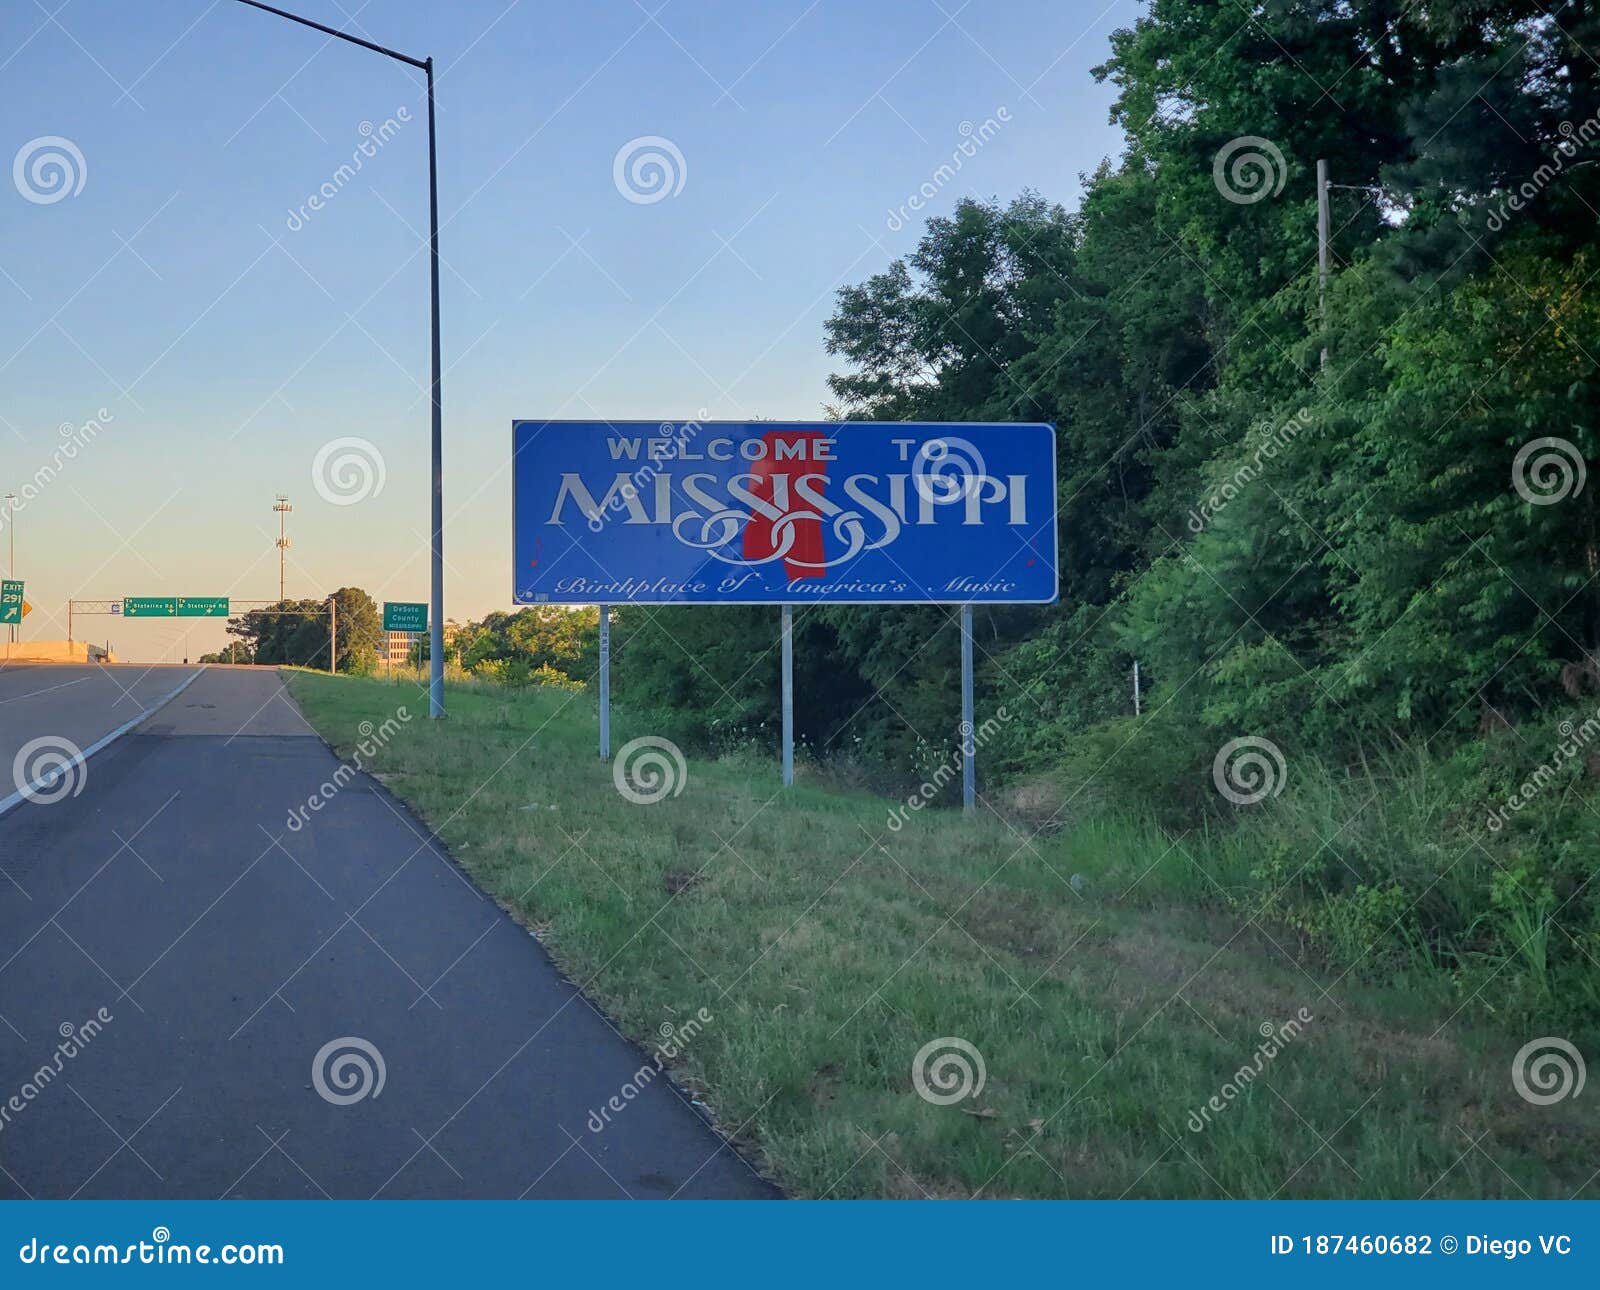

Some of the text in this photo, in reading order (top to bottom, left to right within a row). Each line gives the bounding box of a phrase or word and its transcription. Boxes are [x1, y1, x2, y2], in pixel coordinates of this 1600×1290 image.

[607, 438, 949, 461] WELCOME TO
[544, 472, 1030, 568] MISSISSIPPI
[3, 583, 24, 591] EXIT
[554, 576, 708, 599] Birthplace
[764, 576, 907, 593] America's
[927, 576, 1016, 593] Music
[3, 594, 21, 604] 291
[392, 614, 420, 623] County
